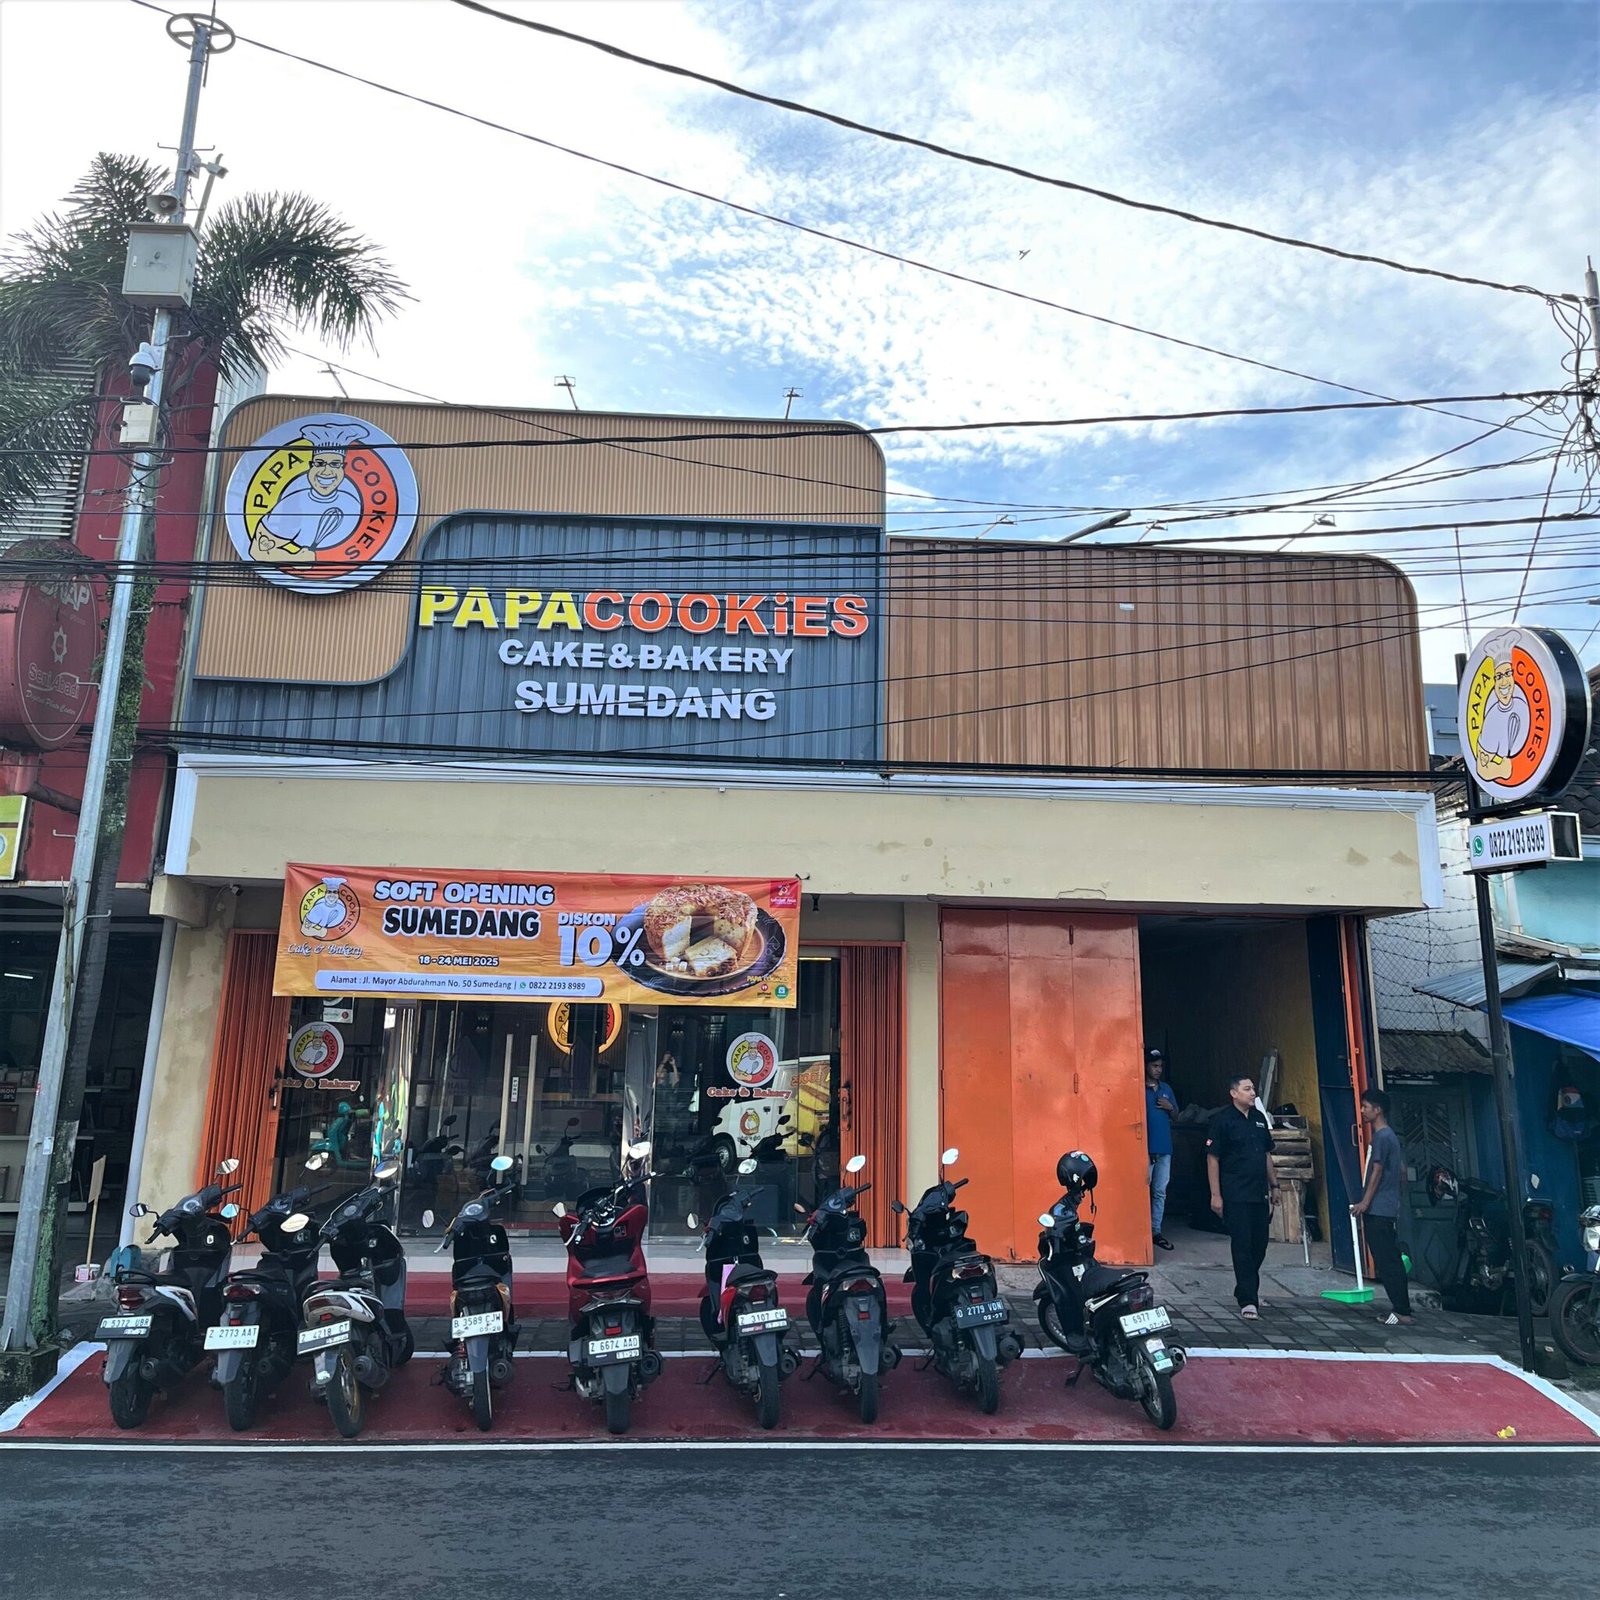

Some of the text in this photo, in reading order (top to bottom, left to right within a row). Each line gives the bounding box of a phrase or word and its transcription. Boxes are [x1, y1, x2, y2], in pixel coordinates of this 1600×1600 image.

[254, 452, 388, 560] PAPA COOKIES
[418, 585, 583, 630] PAPA
[514, 680, 777, 720] SUMEDANG
[1471, 660, 1545, 762] PAPA COOKIES
[1489, 824, 1545, 858] 0822 2193 8989
[374, 879, 555, 906] SOFT OPENING
[303, 888, 357, 933] PAPA COOKIES
[382, 906, 541, 939] SUMEDANG
[558, 912, 617, 927] DISKON
[287, 943, 312, 957] Cake
[327, 944, 363, 959] Bakery
[557, 926, 646, 968] 10%
[418, 954, 431, 965] 18
[438, 955, 452, 966] 24
[453, 955, 473, 966] MEI
[473, 956, 499, 967] 2025
[330, 975, 357, 984] Alamat
[372, 977, 396, 987] Mayor
[398, 977, 446, 987] Abdurahman
[462, 980, 472, 988] 50
[473, 980, 512, 990] Sumedang
[529, 981, 546, 989] 0822
[548, 982, 566, 990] 2193
[567, 982, 586, 990] 8989
[733, 1044, 748, 1063] PAPA
[319, 1078, 361, 1092] Bakery
[707, 1087, 737, 1098] Cake
[753, 1088, 792, 1100] Bakery
[751, 1312, 770, 1323] 3107
[966, 1304, 986, 1316] 2779
[1132, 1312, 1150, 1324] 6977
[1155, 1308, 1166, 1318] BU
[454, 1319, 460, 1328] B
[463, 1316, 483, 1327] 3589
[209, 1327, 257, 1338] Z 2773 AAT
[590, 1342, 595, 1352] Z
[600, 1340, 620, 1351] 6674
